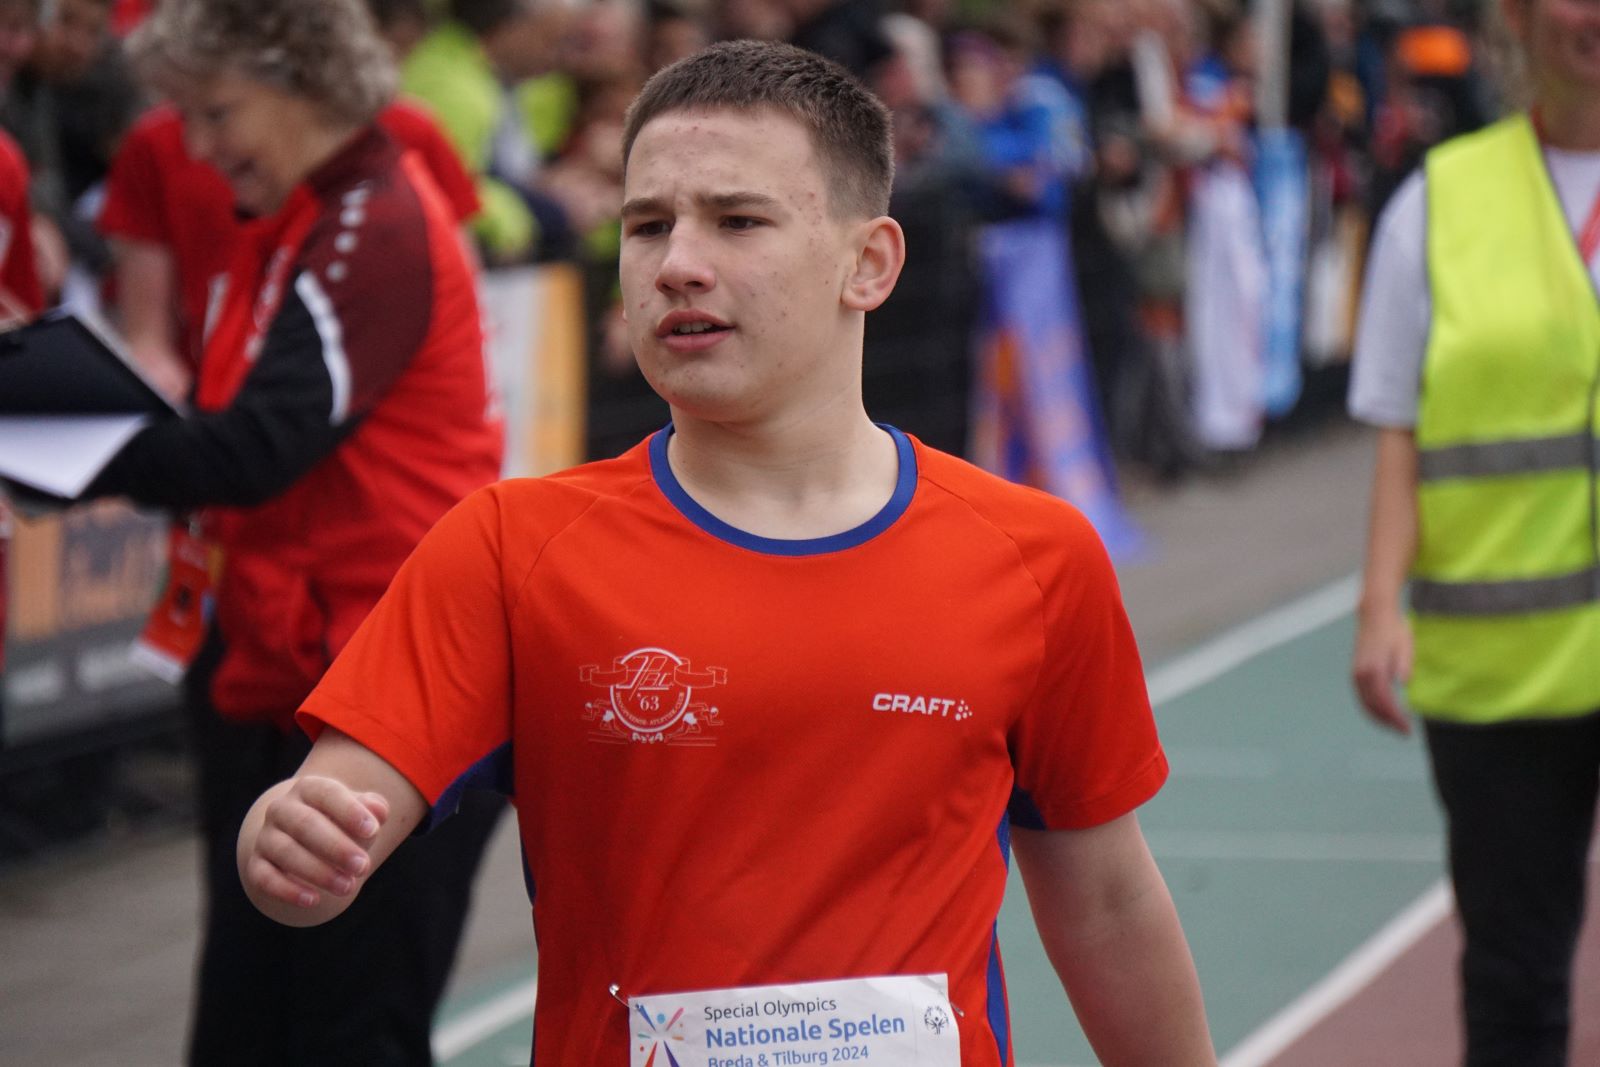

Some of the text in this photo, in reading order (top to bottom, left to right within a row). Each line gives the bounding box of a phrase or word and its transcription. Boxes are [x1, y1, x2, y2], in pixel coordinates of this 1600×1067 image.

[872, 693, 956, 717] CRAFT
[704, 997, 837, 1023] Special Olympics
[705, 1013, 905, 1049] Nationale Spelen
[708, 1045, 869, 1067] Breda & Tilburg 2024
